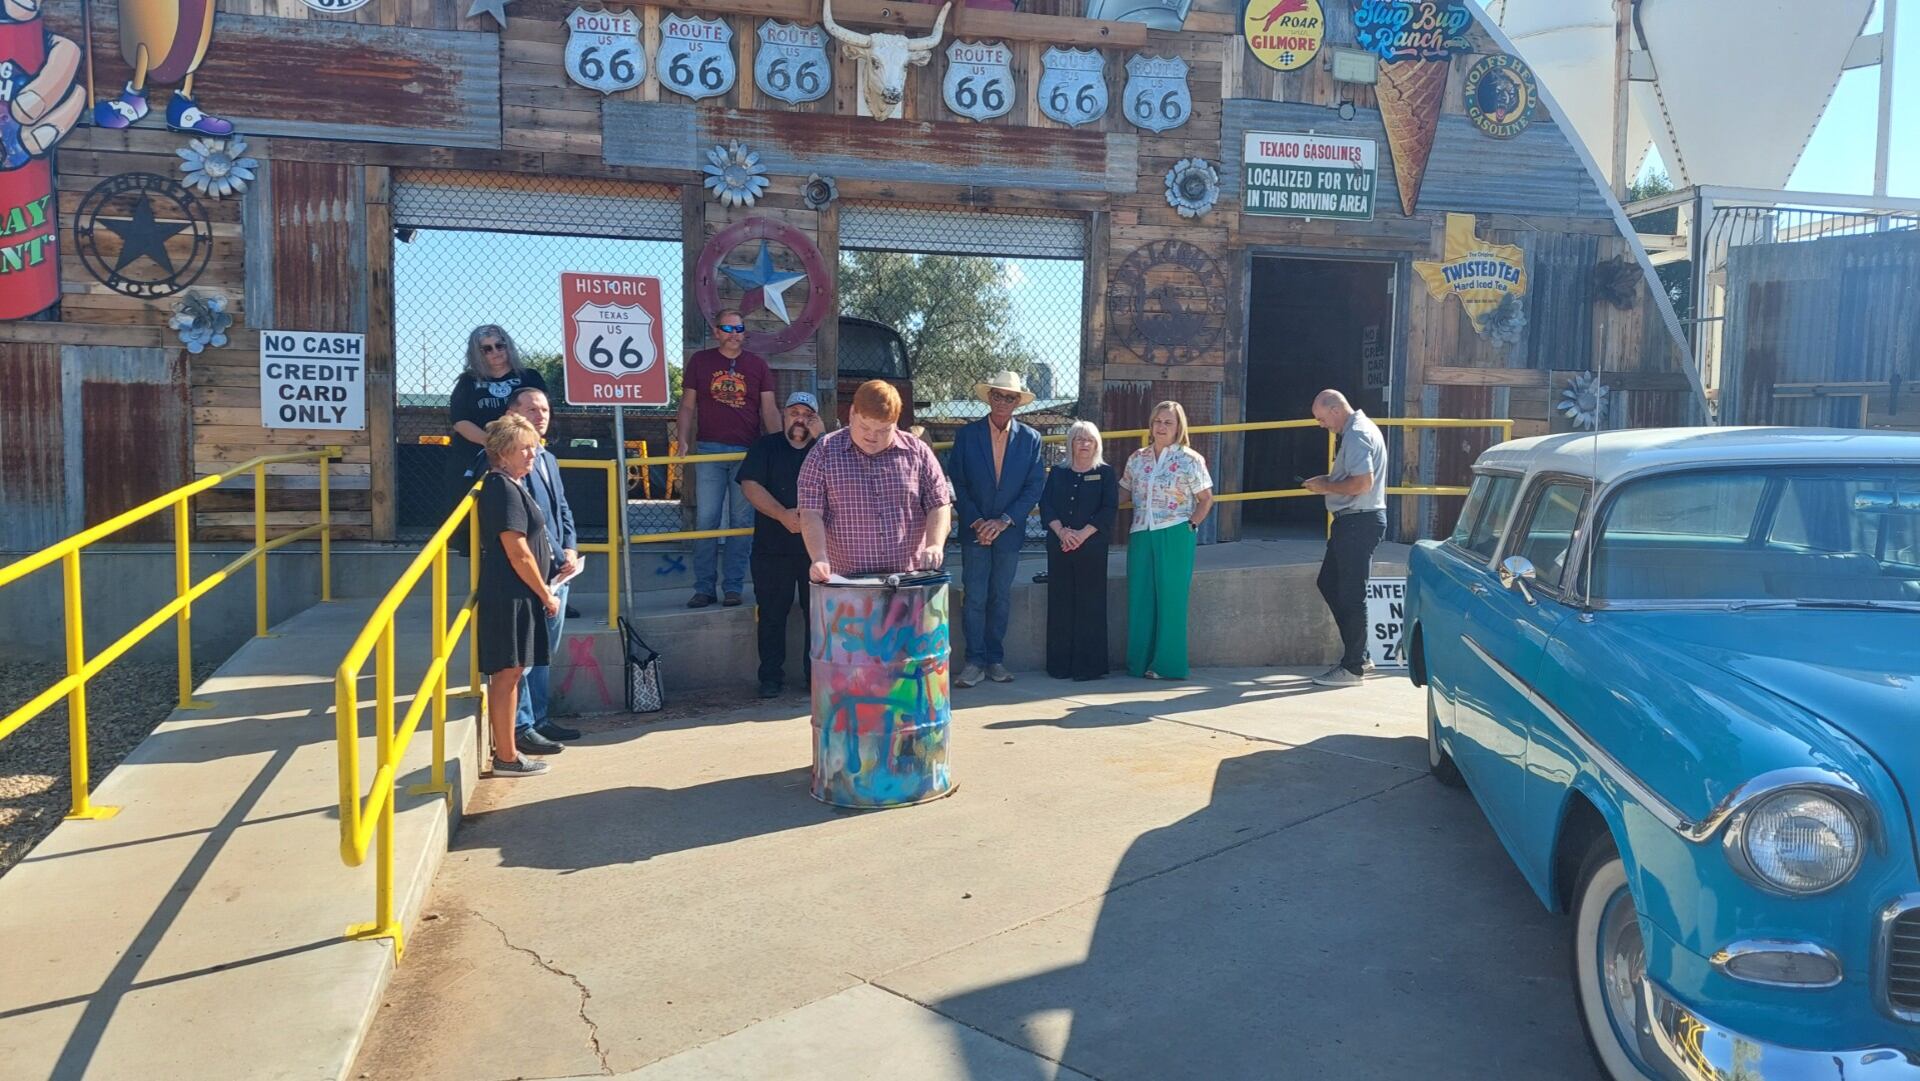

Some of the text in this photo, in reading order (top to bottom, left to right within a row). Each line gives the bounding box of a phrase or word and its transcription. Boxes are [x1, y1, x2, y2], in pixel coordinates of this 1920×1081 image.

[576, 16, 631, 33] ROUTE
[1280, 16, 1318, 28] ROAR
[1354, 0, 1472, 34] Slug Bug
[598, 36, 613, 46] US
[669, 22, 722, 41] ROUTE
[767, 27, 818, 46] ROUTE
[689, 42, 703, 52] US
[786, 47, 800, 57] US
[1251, 35, 1316, 51] GILMORE
[1370, 27, 1448, 59] Ranch
[579, 47, 635, 83] 66
[954, 48, 1003, 64] ROUTE
[1050, 53, 1098, 70] ROUTE
[0, 61, 13, 79] G
[669, 52, 724, 90] 66
[767, 58, 820, 94] 66
[972, 66, 985, 76] US
[1133, 62, 1181, 76] ROUTE
[1465, 55, 1537, 108] WOLF'S HEAD
[955, 76, 1006, 111] 66
[1050, 82, 1098, 114] 66
[1134, 89, 1182, 120] 66
[1469, 106, 1529, 136] GASOLINE
[1260, 141, 1362, 161] TEXACO GASOLINES
[1247, 167, 1371, 192] LOCALIZED FOR YOU
[1247, 190, 1368, 213] IN THIS DRIVING AREA
[0, 194, 50, 235] AY
[1441, 260, 1521, 285] TWISTED TEA
[107, 272, 183, 297] BOCK
[576, 279, 647, 296] HISTORIC
[1453, 280, 1508, 291] Hard Iced Tea
[599, 311, 629, 320] TEXAS
[607, 325, 622, 335] US
[266, 335, 360, 354] NO CASH
[588, 334, 643, 369] 66
[266, 362, 360, 382] CREDIT
[278, 384, 347, 402] CARD
[593, 384, 643, 399] ROUTE
[279, 404, 348, 424] ONLY
[1390, 602, 1403, 619] N
[1375, 623, 1403, 640] SP
